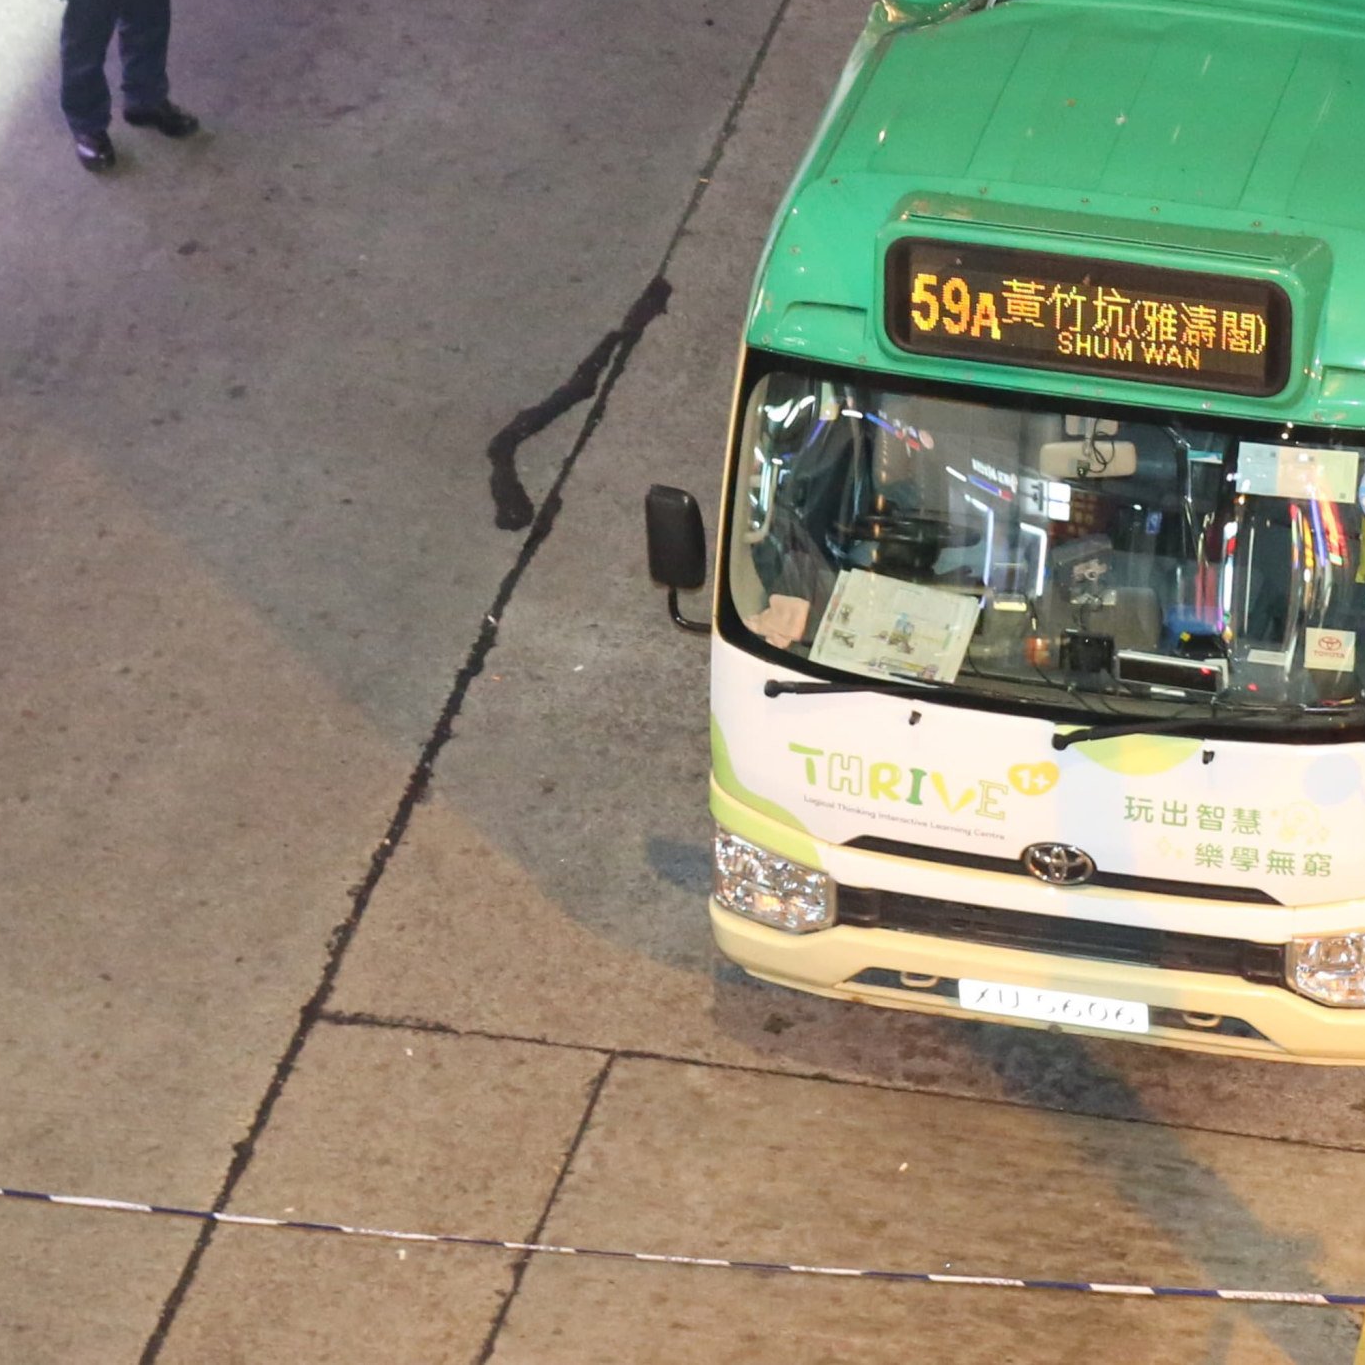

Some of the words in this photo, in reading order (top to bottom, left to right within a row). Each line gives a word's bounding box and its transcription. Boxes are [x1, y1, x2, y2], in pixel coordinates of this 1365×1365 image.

[911, 273, 1002, 341] 59A
[1058, 333, 1133, 363] SHUM
[1143, 346, 1201, 371] WAN
[788, 742, 1009, 821] THRIVE
[803, 794, 836, 810] Logical
[837, 803, 876, 819] Thinking
[930, 821, 972, 837] Learning
[973, 828, 1005, 841] Centre
[1123, 795, 1262, 835] 玩出智慧
[1194, 843, 1333, 877] 樂學無窮
